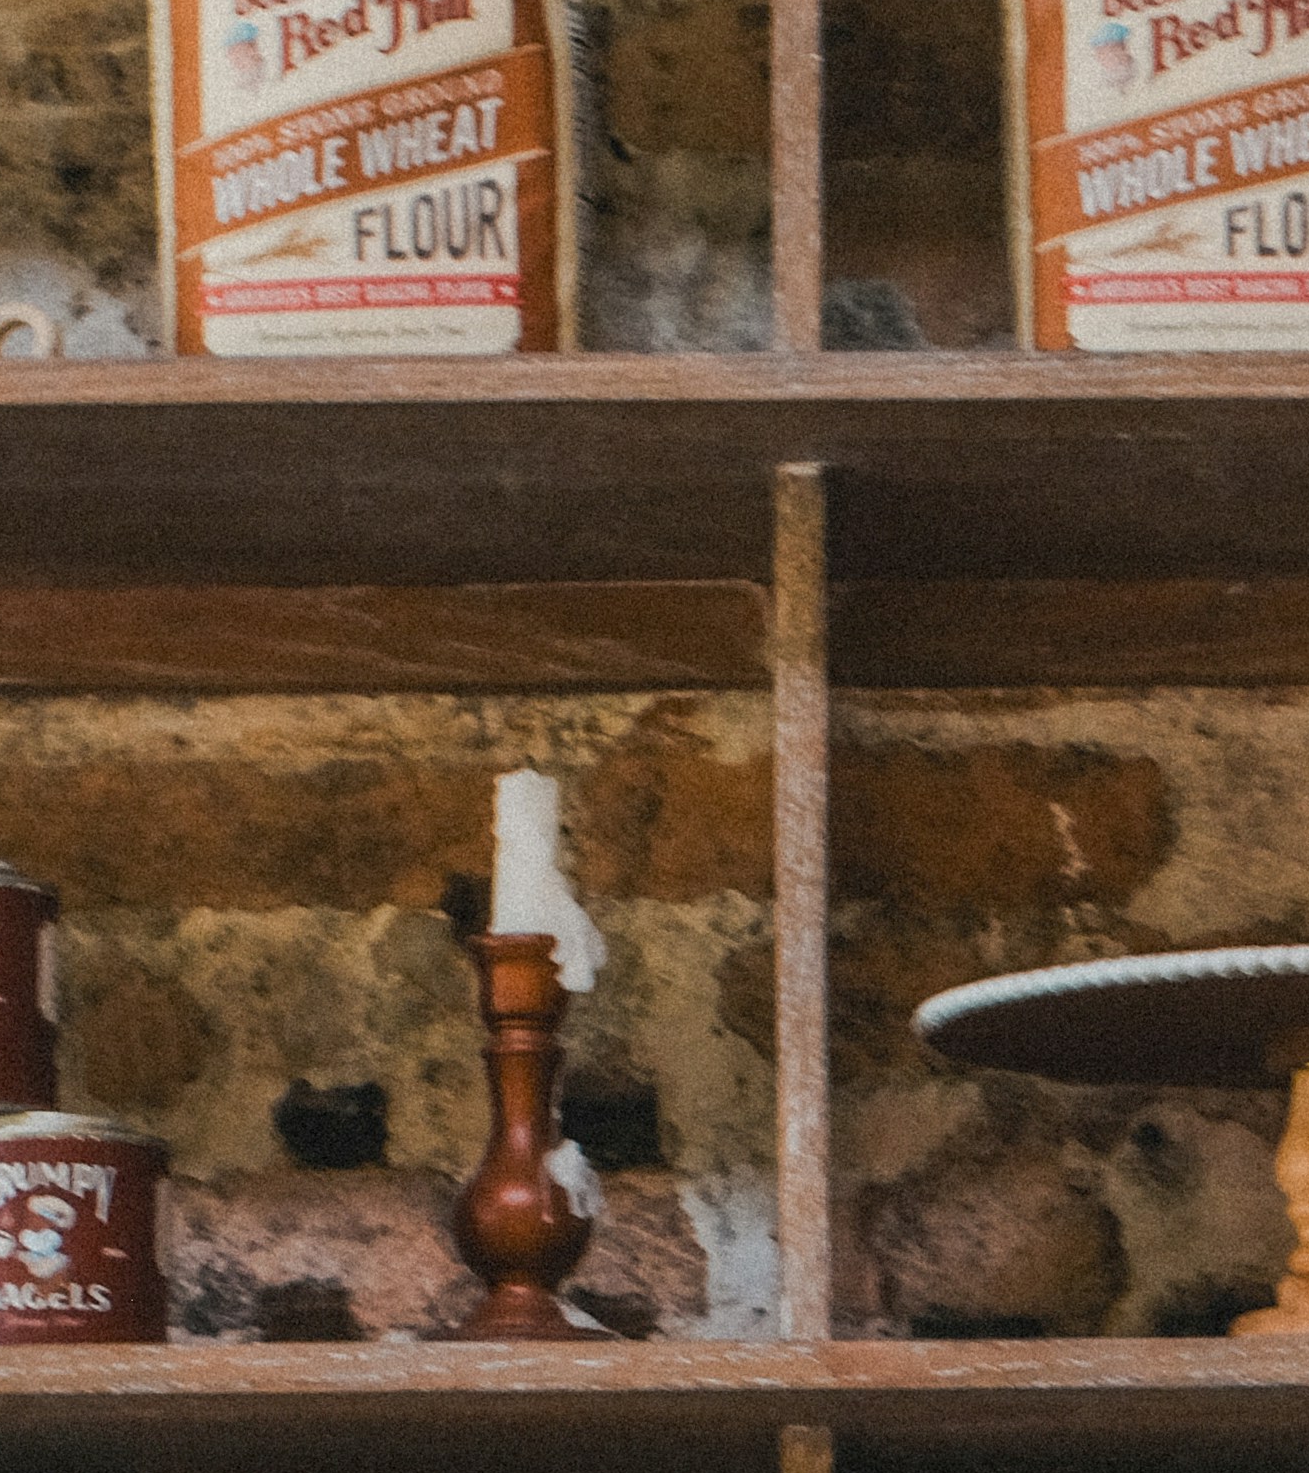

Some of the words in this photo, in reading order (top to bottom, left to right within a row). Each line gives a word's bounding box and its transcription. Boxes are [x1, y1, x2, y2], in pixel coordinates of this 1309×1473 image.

[1150, 0, 1243, 75] Red
[212, 136, 349, 224] WHOLE
[359, 97, 506, 177] WHEAT
[1077, 136, 1221, 219] WHOLE
[353, 179, 507, 263] FLOUR
